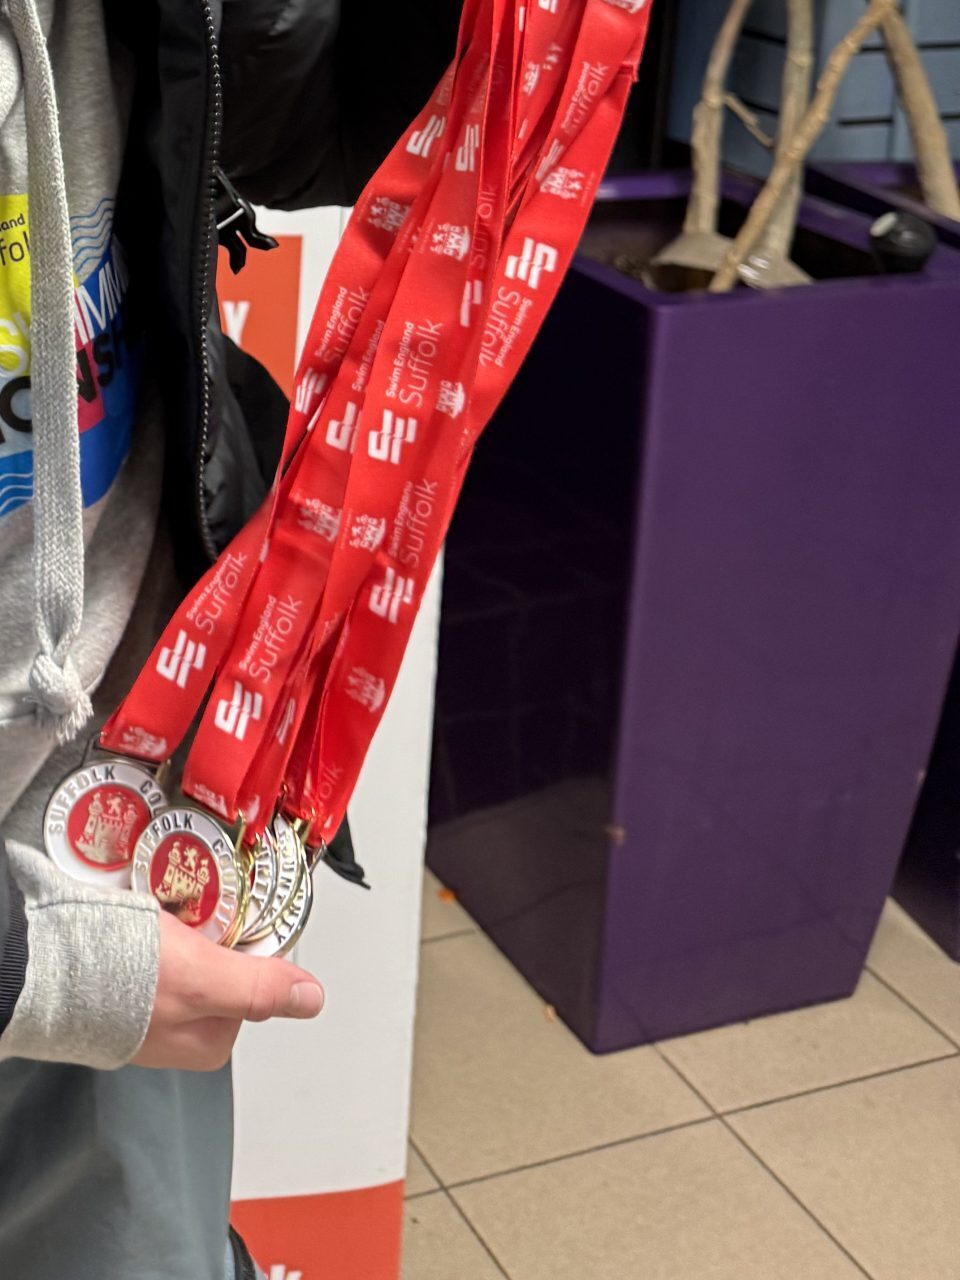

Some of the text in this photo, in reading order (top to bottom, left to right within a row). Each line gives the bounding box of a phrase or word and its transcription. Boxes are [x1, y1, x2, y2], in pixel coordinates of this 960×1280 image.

[325, 286, 348, 332] England
[351, 365, 370, 392] Swim
[385, 321, 415, 398] Swim England
[398, 318, 444, 408] Suffolk
[494, 323, 520, 368] England
[399, 477, 439, 569] Suffolk
[194, 550, 248, 635] Suffolk
[253, 594, 277, 640] England
[247, 594, 303, 684] Suffolk
[48, 765, 116, 837] SUFFOLK
[135, 814, 194, 872] SUFFOLK
